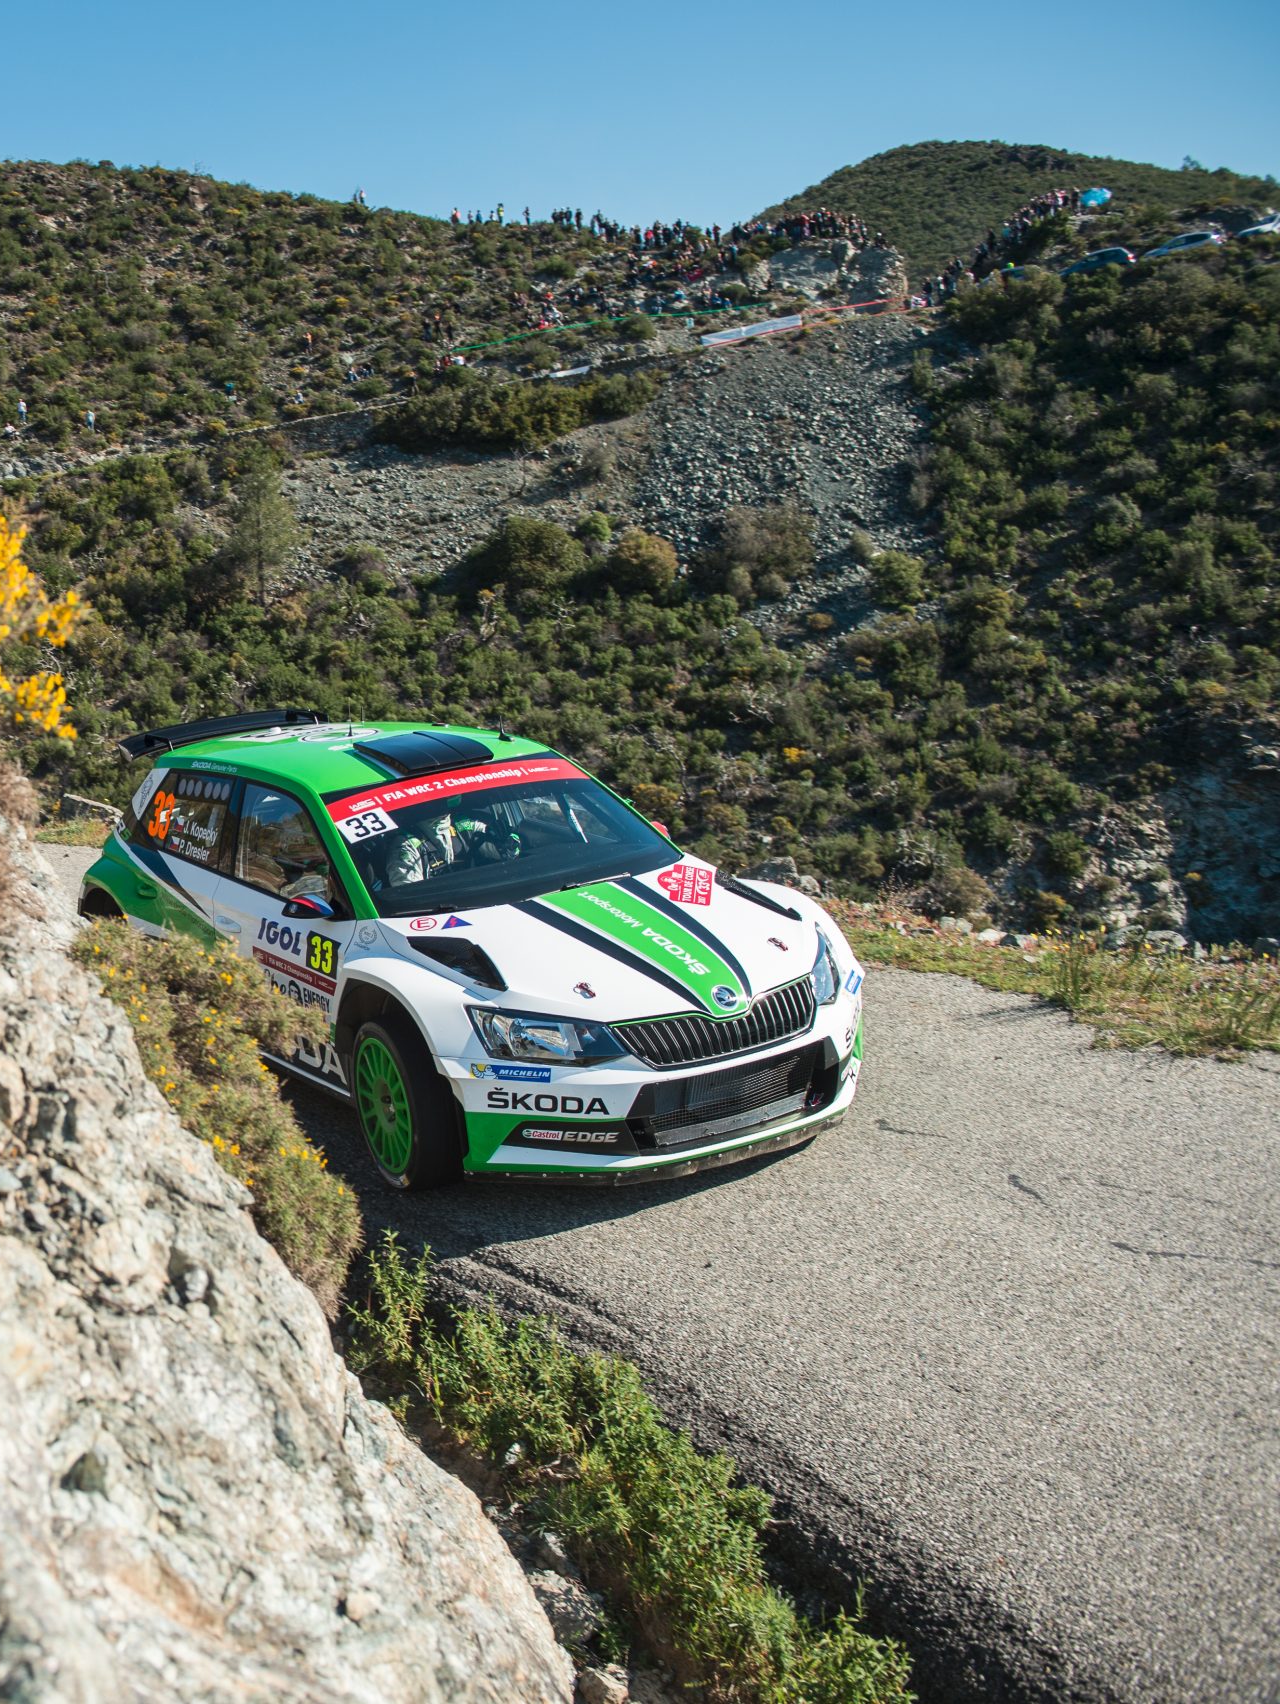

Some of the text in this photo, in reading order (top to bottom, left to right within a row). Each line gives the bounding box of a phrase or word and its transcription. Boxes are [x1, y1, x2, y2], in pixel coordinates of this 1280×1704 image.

[383, 791, 407, 802] FIA
[405, 783, 435, 796] WRC
[433, 781, 444, 789] 2
[444, 767, 522, 788] Championship
[148, 791, 175, 839] 33
[345, 812, 387, 838] 33
[183, 820, 219, 846] J. Kopecký
[179, 839, 210, 861] P. Dresler
[698, 882, 711, 891] 33
[257, 918, 301, 955] IGOL
[577, 891, 711, 976] ŠKODA Motorsport
[310, 935, 333, 974] 33
[498, 1068, 551, 1079] MICHELIN
[487, 1087, 610, 1116] ŠKODA
[530, 1130, 619, 1143] Castrol EDGE
